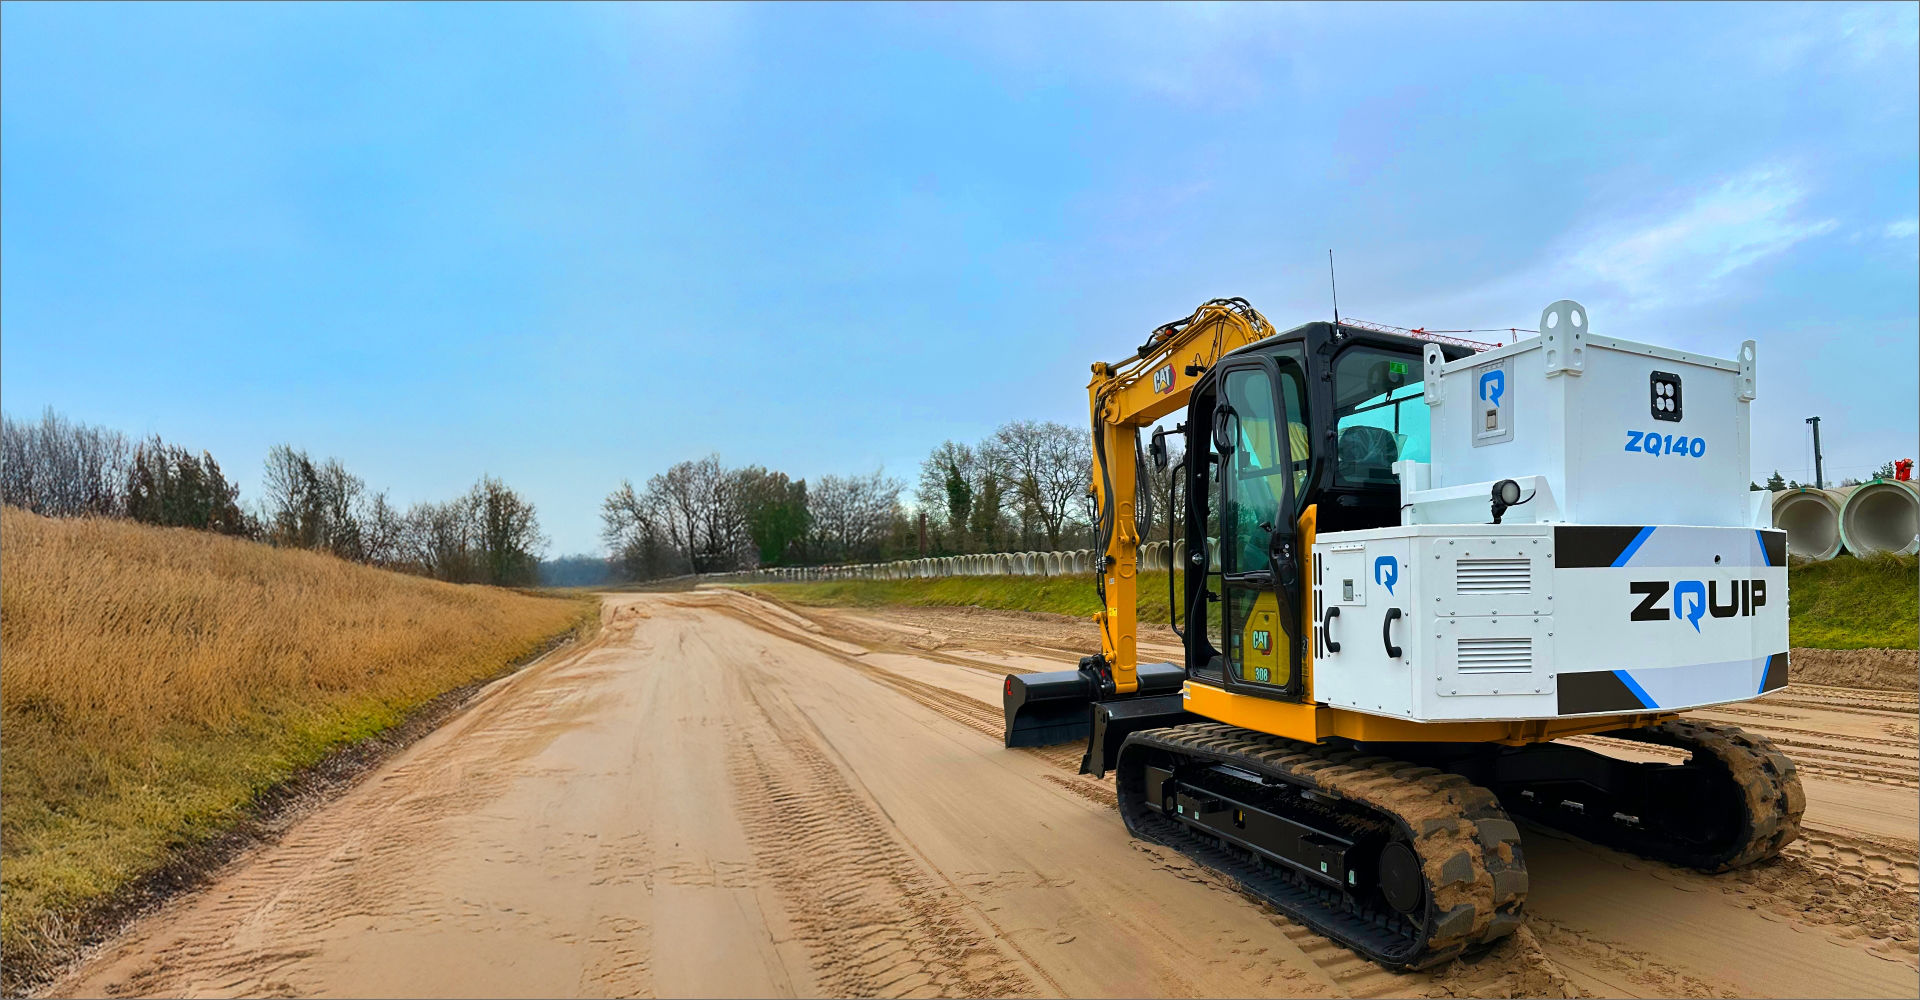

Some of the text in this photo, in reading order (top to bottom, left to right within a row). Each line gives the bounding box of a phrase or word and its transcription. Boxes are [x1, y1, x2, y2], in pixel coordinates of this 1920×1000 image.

[1153, 364, 1171, 393] CAT
[1624, 430, 1706, 458] ZQ140
[1629, 579, 1767, 634] ZQUIP
[1253, 630, 1269, 650] CAT
[1255, 667, 1268, 682] 308
